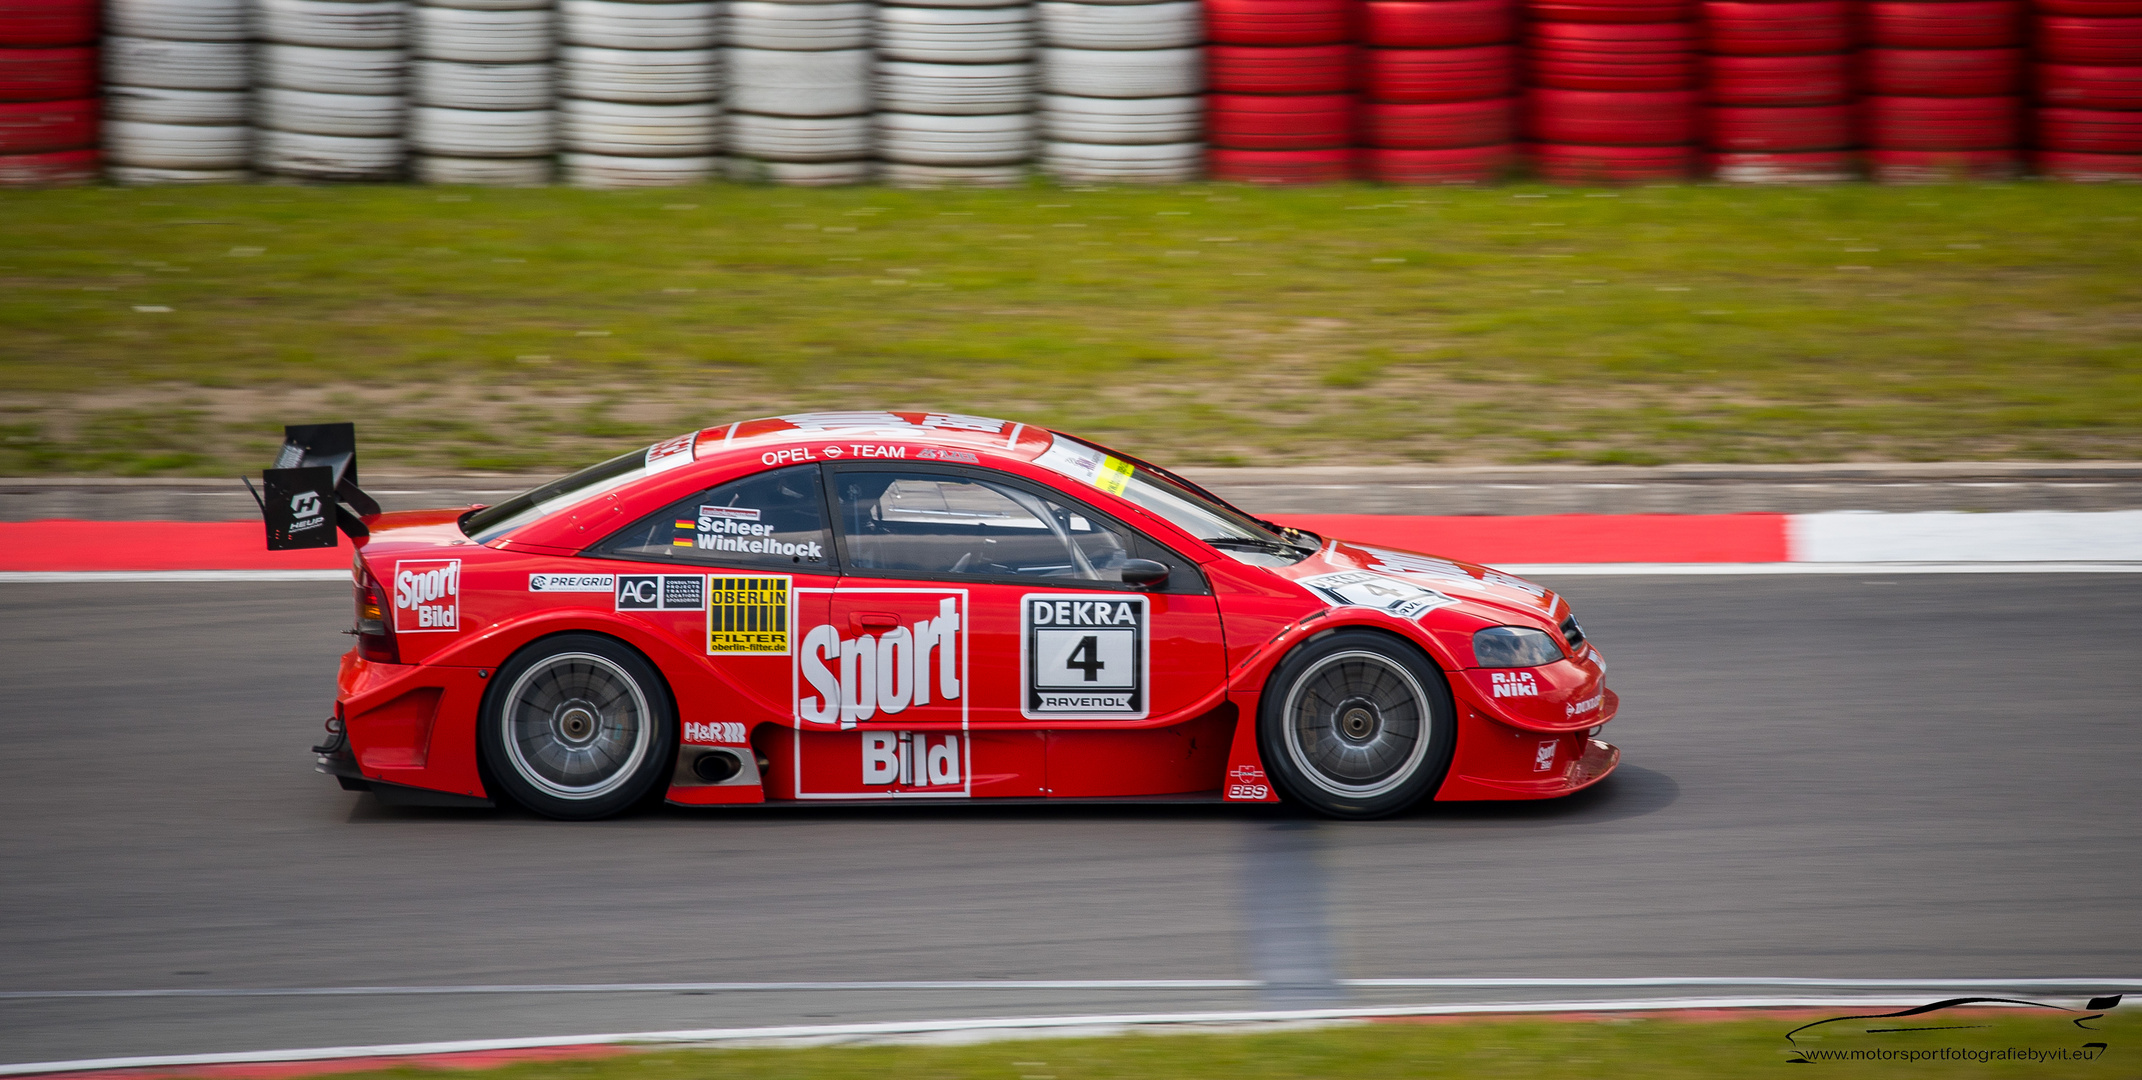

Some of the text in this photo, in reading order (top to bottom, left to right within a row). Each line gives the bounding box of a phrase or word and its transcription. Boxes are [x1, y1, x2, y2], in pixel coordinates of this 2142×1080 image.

[761, 445, 905, 466] OPEL TEAM
[289, 516, 325, 530] HEUP
[697, 517, 775, 536] Scheer
[697, 533, 823, 558] Winkelhock
[397, 561, 457, 611] Sport
[550, 577, 613, 586] PRE/GRID
[1363, 583, 1404, 597] 4
[619, 580, 657, 603] AC
[712, 591, 786, 604] OBERLIN
[418, 605, 455, 627] Bild
[1033, 601, 1137, 625] DEKRA
[712, 634, 786, 643] FILTER
[712, 643, 786, 651] oberlin-filter.de
[800, 597, 960, 730] Sport
[1066, 635, 1105, 682] 4
[1491, 672, 1536, 683] R.I.P.
[1493, 682, 1538, 698] Niki
[1046, 697, 1125, 707] RAVENOL
[684, 722, 737, 743] H&R
[862, 731, 960, 786] Bild
[1228, 784, 1268, 799] BBS
